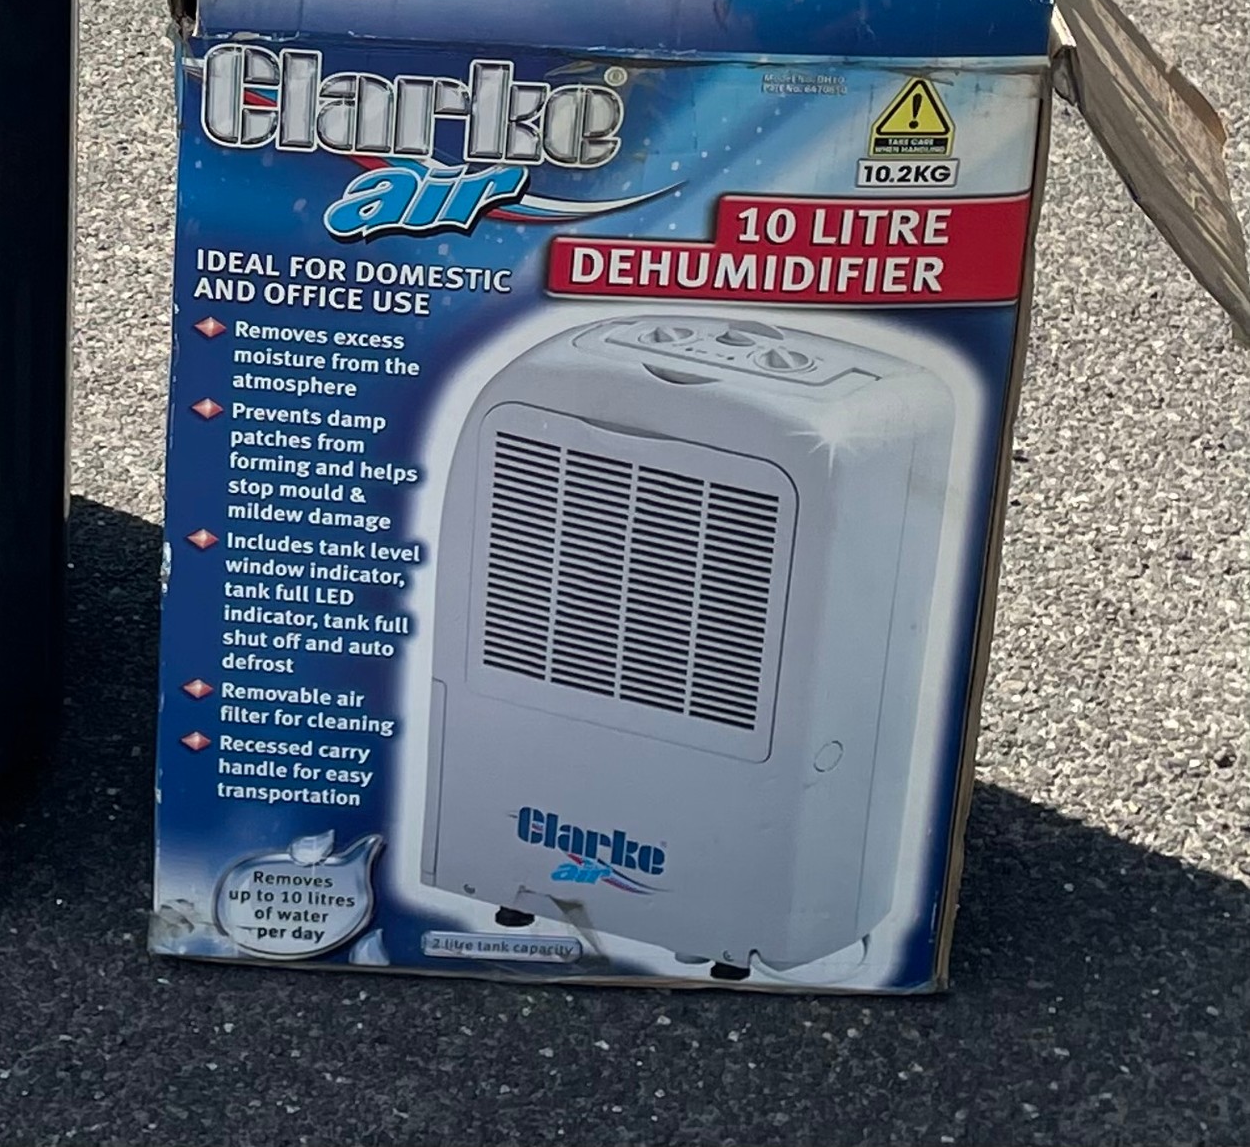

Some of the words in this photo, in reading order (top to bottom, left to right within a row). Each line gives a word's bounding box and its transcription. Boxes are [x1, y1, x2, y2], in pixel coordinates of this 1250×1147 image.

[202, 43, 624, 168] Clarke
[864, 165, 951, 182] 10.2KG
[323, 163, 530, 241] air
[738, 208, 797, 244] 10
[812, 209, 952, 246] LITRE
[196, 249, 280, 277] IDEAL
[290, 256, 346, 282] FOR
[355, 260, 512, 293] DOMESTIC
[571, 247, 946, 293] DEHUMIDIFIER
[194, 277, 255, 302] AND
[263, 282, 364, 311] OFFICE
[373, 290, 430, 316] USE
[235, 321, 328, 345] Removes
[333, 331, 405, 350] excess
[234, 348, 326, 369] moisture
[331, 353, 379, 374] from
[385, 357, 420, 376] the
[232, 373, 357, 397] atmosphere
[232, 403, 322, 426] Prevents
[327, 409, 386, 433] damp
[230, 430, 312, 449] patches
[317, 433, 365, 454] from
[229, 452, 311, 478] forming
[315, 460, 354, 478] and
[360, 462, 419, 484] helps
[228, 478, 274, 499] stop
[279, 483, 344, 501] mould
[349, 487, 366, 503] &
[227, 503, 303, 523] mildew
[308, 508, 391, 532] damage
[227, 533, 314, 554] Includes
[319, 539, 365, 559] tank
[370, 542, 420, 562] level
[225, 557, 305, 578] window
[309, 562, 406, 588] indicator,
[224, 581, 270, 600] tank
[275, 584, 309, 602] full
[316, 587, 354, 605] LED
[224, 605, 318, 629] indicator,
[324, 611, 370, 631] tank
[374, 615, 409, 634] full
[223, 630, 268, 648] shut
[272, 633, 302, 650] off
[305, 637, 343, 653] and
[348, 641, 394, 656] auto
[222, 653, 294, 674] defrost
[221, 682, 331, 706] Removable
[337, 690, 365, 708] air
[220, 705, 270, 724] filter
[274, 708, 303, 726] for
[307, 713, 395, 737] cleaning
[220, 735, 313, 757] Recessed
[318, 744, 371, 764] carry
[218, 758, 288, 778] handle
[293, 762, 321, 780] for
[325, 769, 373, 787] easy
[217, 783, 360, 806] transportation
[518, 806, 665, 875] Clarke
[254, 871, 333, 888] Removes
[551, 858, 612, 884] air
[229, 890, 251, 904] up
[257, 890, 274, 902] to
[281, 891, 302, 904] 10
[308, 892, 355, 907] litres
[254, 907, 273, 920] of
[278, 910, 329, 923] water
[257, 927, 287, 939] per
[292, 927, 325, 943] day
[432, 938, 440, 949] 2
[445, 938, 474, 950] litre
[478, 940, 509, 952] tank
[513, 943, 574, 956] capacity
